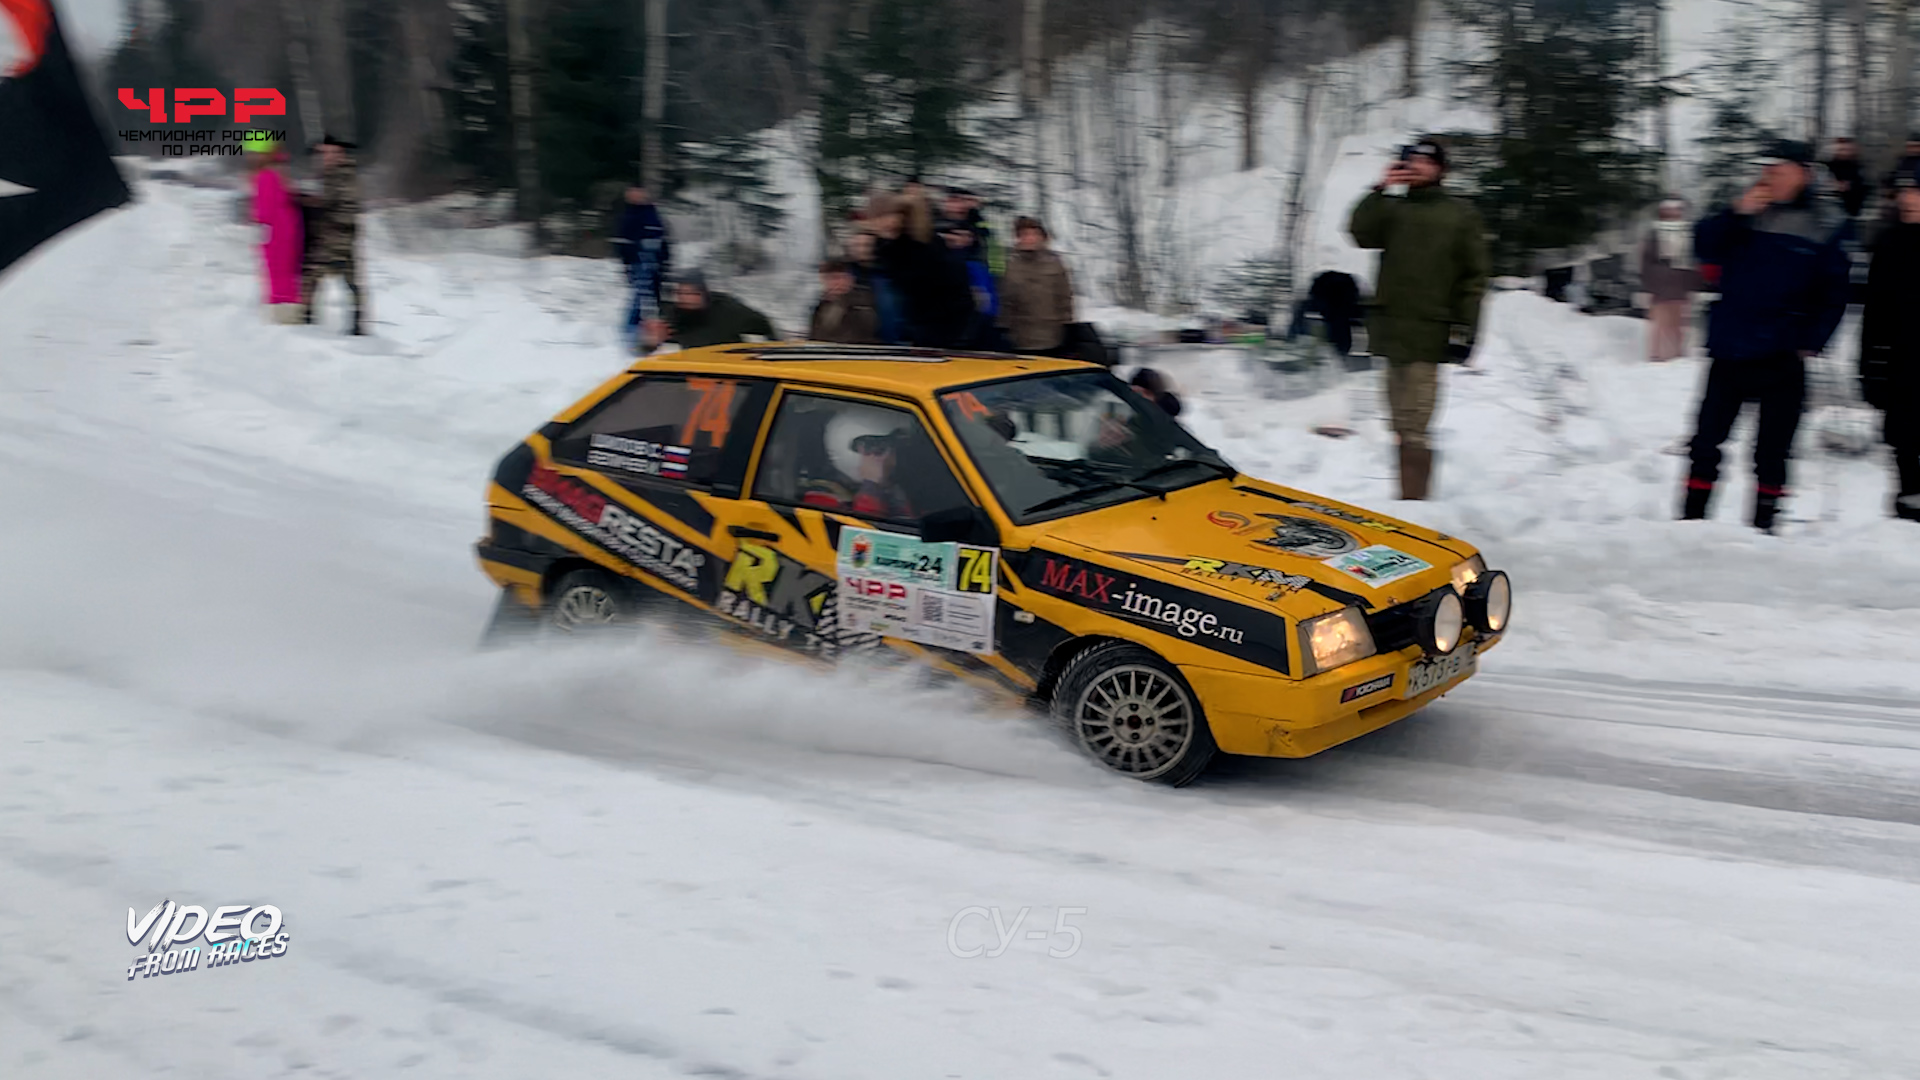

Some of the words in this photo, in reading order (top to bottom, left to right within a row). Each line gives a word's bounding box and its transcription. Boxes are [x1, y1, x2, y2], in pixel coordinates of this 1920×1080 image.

[682, 378, 736, 448] 74
[941, 392, 994, 422] 74
[959, 549, 993, 592] 74
[717, 590, 795, 639] RALLY
[1041, 558, 1244, 644] MAX-image.ru
